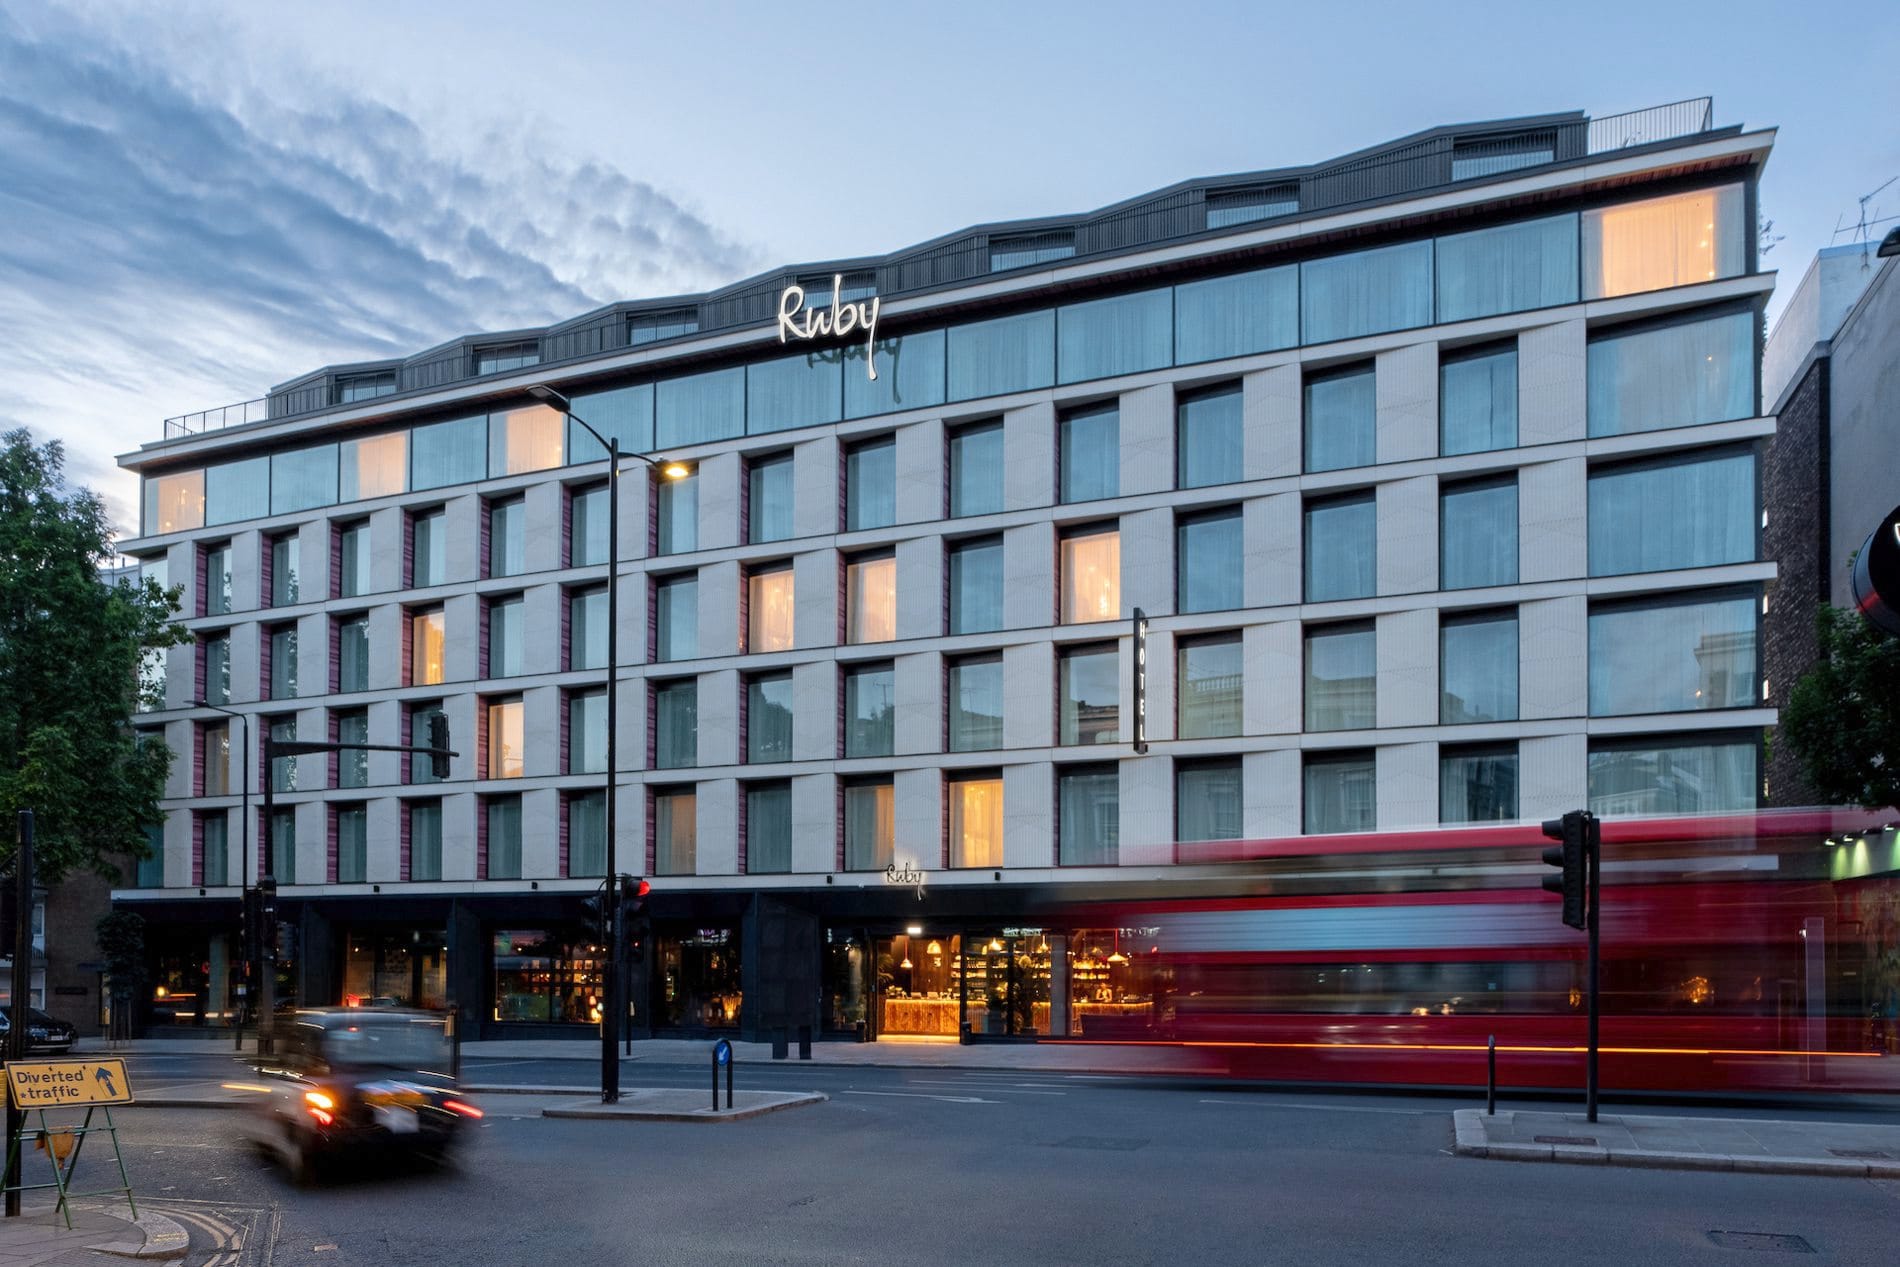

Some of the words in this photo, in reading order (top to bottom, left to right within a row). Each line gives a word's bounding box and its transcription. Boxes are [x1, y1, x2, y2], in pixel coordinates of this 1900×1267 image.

[778, 274, 880, 380] Ruby
[886, 862, 922, 901] Ruby
[16, 1070, 84, 1084] Diverted
[27, 1085, 80, 1099] traffic
